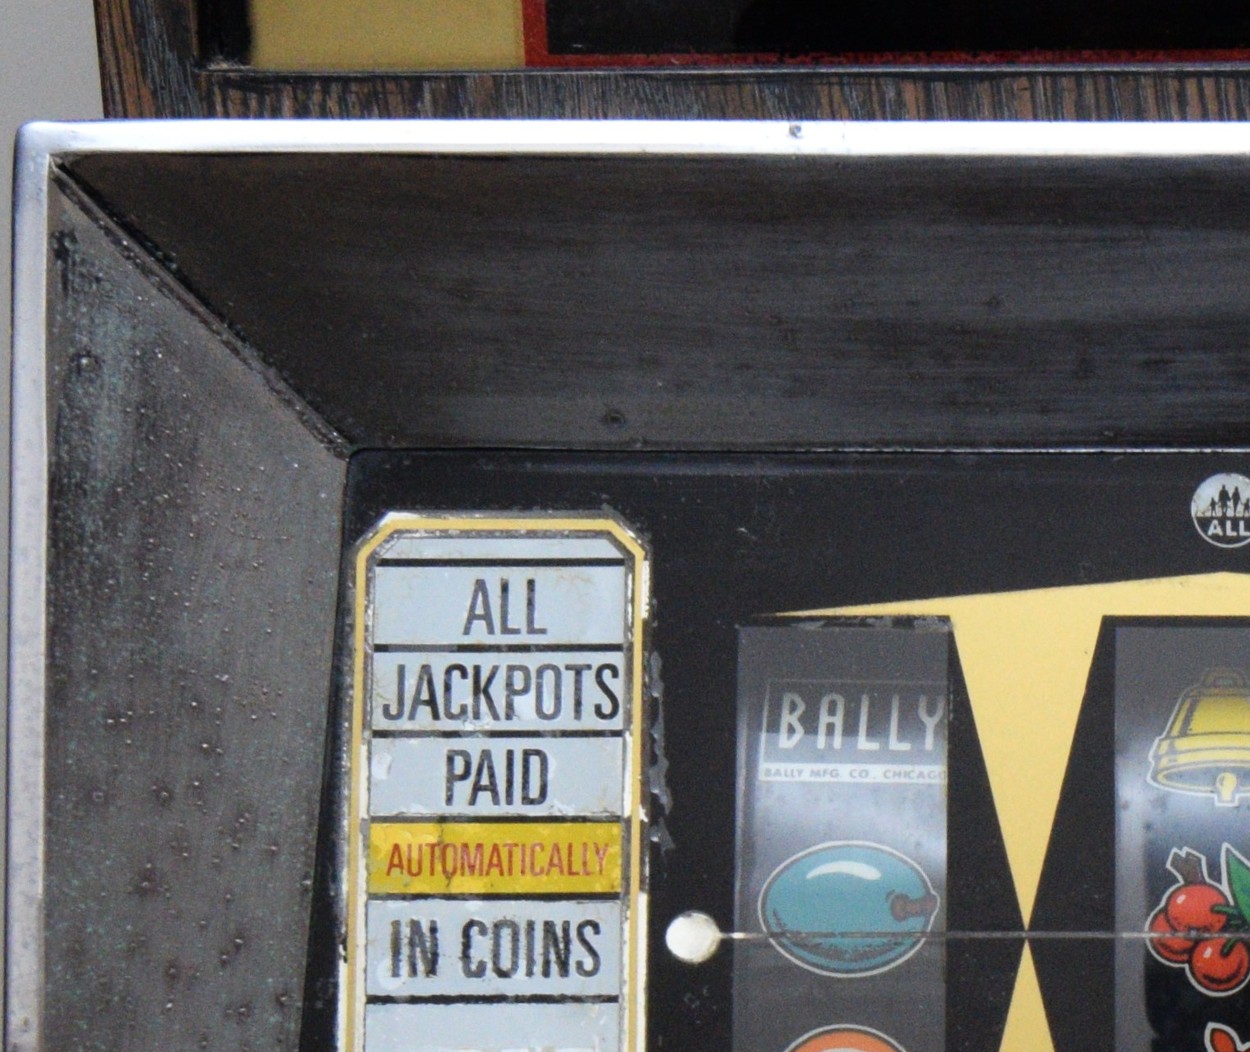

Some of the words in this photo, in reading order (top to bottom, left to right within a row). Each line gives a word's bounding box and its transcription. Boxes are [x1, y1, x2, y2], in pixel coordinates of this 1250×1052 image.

[462, 578, 548, 636] ALL
[382, 663, 620, 721] JACKPOTS
[778, 691, 946, 751] BALLY
[444, 748, 549, 807] PAID
[763, 767, 804, 778] BALLY
[809, 768, 840, 779] MFG
[386, 842, 609, 878] AUTOMATICALLY
[389, 919, 440, 978] IN
[460, 918, 601, 979] COINS
